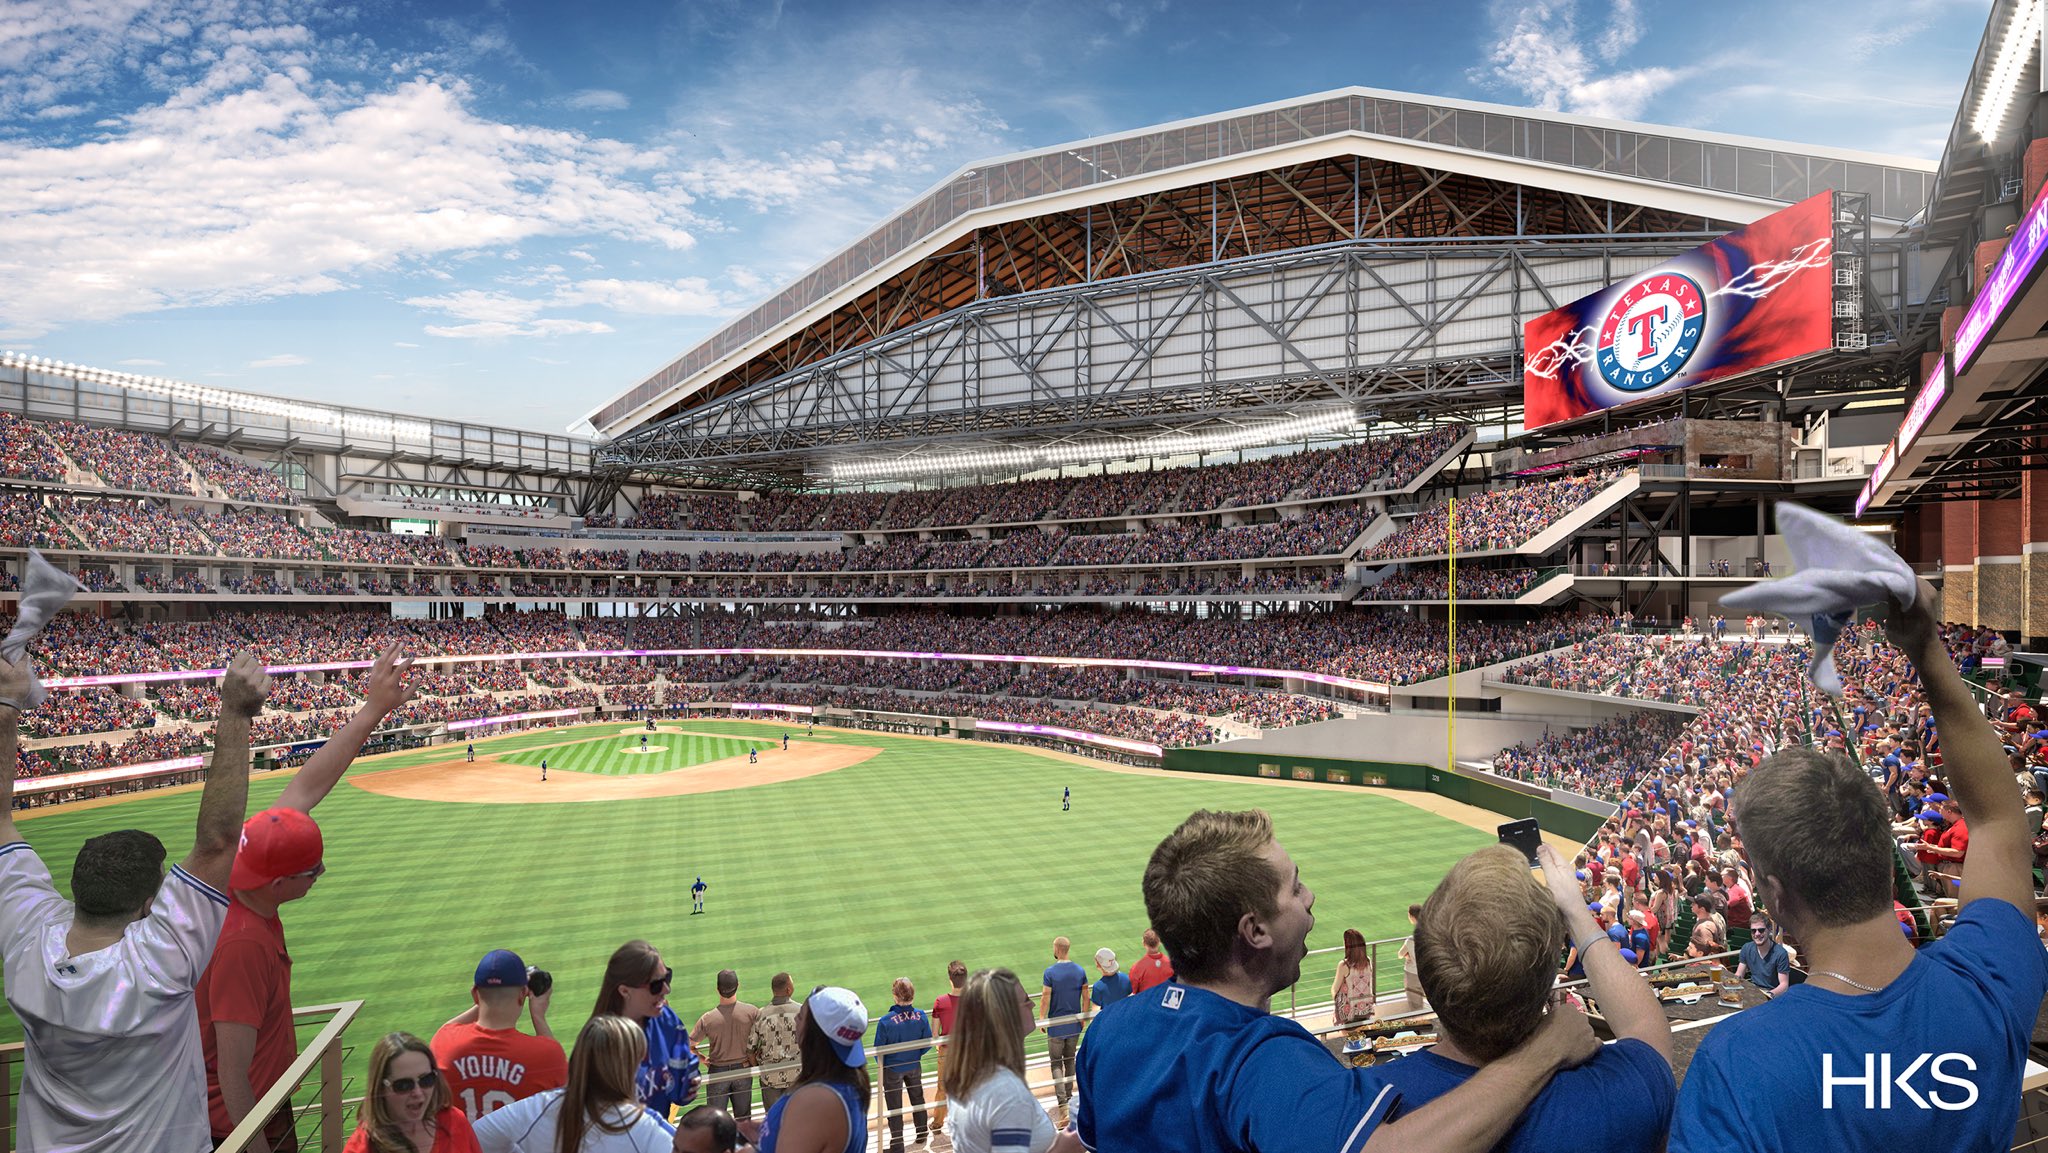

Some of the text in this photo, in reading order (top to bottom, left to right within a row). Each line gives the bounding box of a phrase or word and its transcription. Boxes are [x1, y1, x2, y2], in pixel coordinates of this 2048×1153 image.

[1609, 278, 1688, 321] TEXAS
[1628, 304, 1668, 361] T
[1602, 327, 1697, 386] RANGERS
[1677, 371, 1688, 379] TM
[890, 1011, 921, 1025] TEXAS
[453, 1054, 525, 1086] YOUNG
